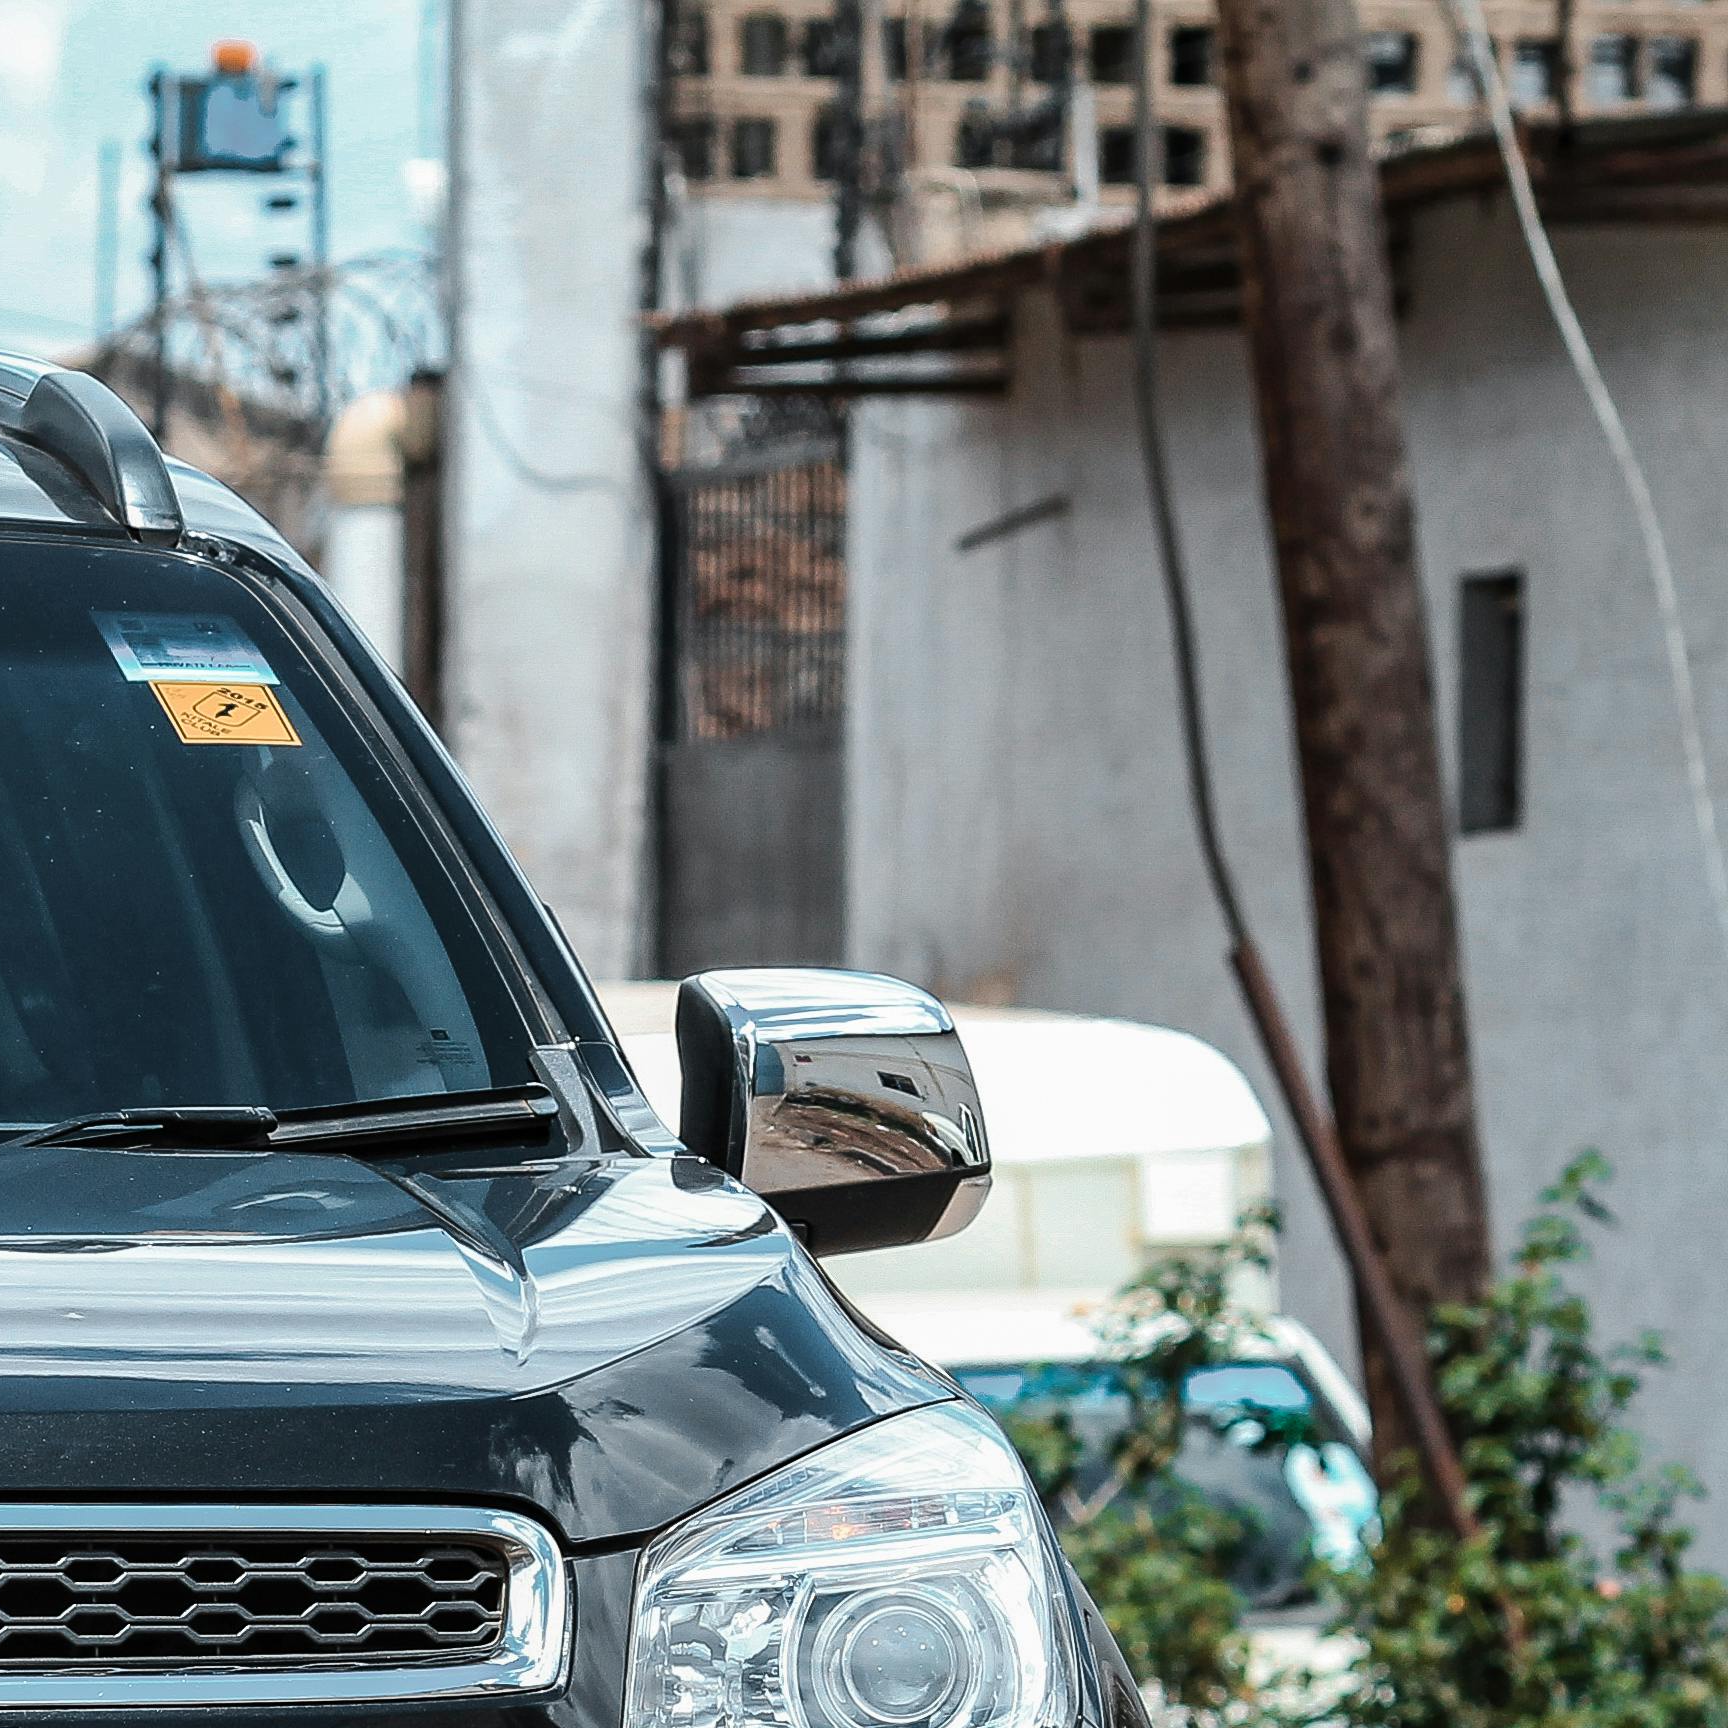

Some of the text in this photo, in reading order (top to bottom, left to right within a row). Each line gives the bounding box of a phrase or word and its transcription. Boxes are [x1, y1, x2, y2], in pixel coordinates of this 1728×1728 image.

[216, 687, 269, 710] 2015
[180, 711, 232, 734] KITALE
[180, 718, 221, 737] CLUB
